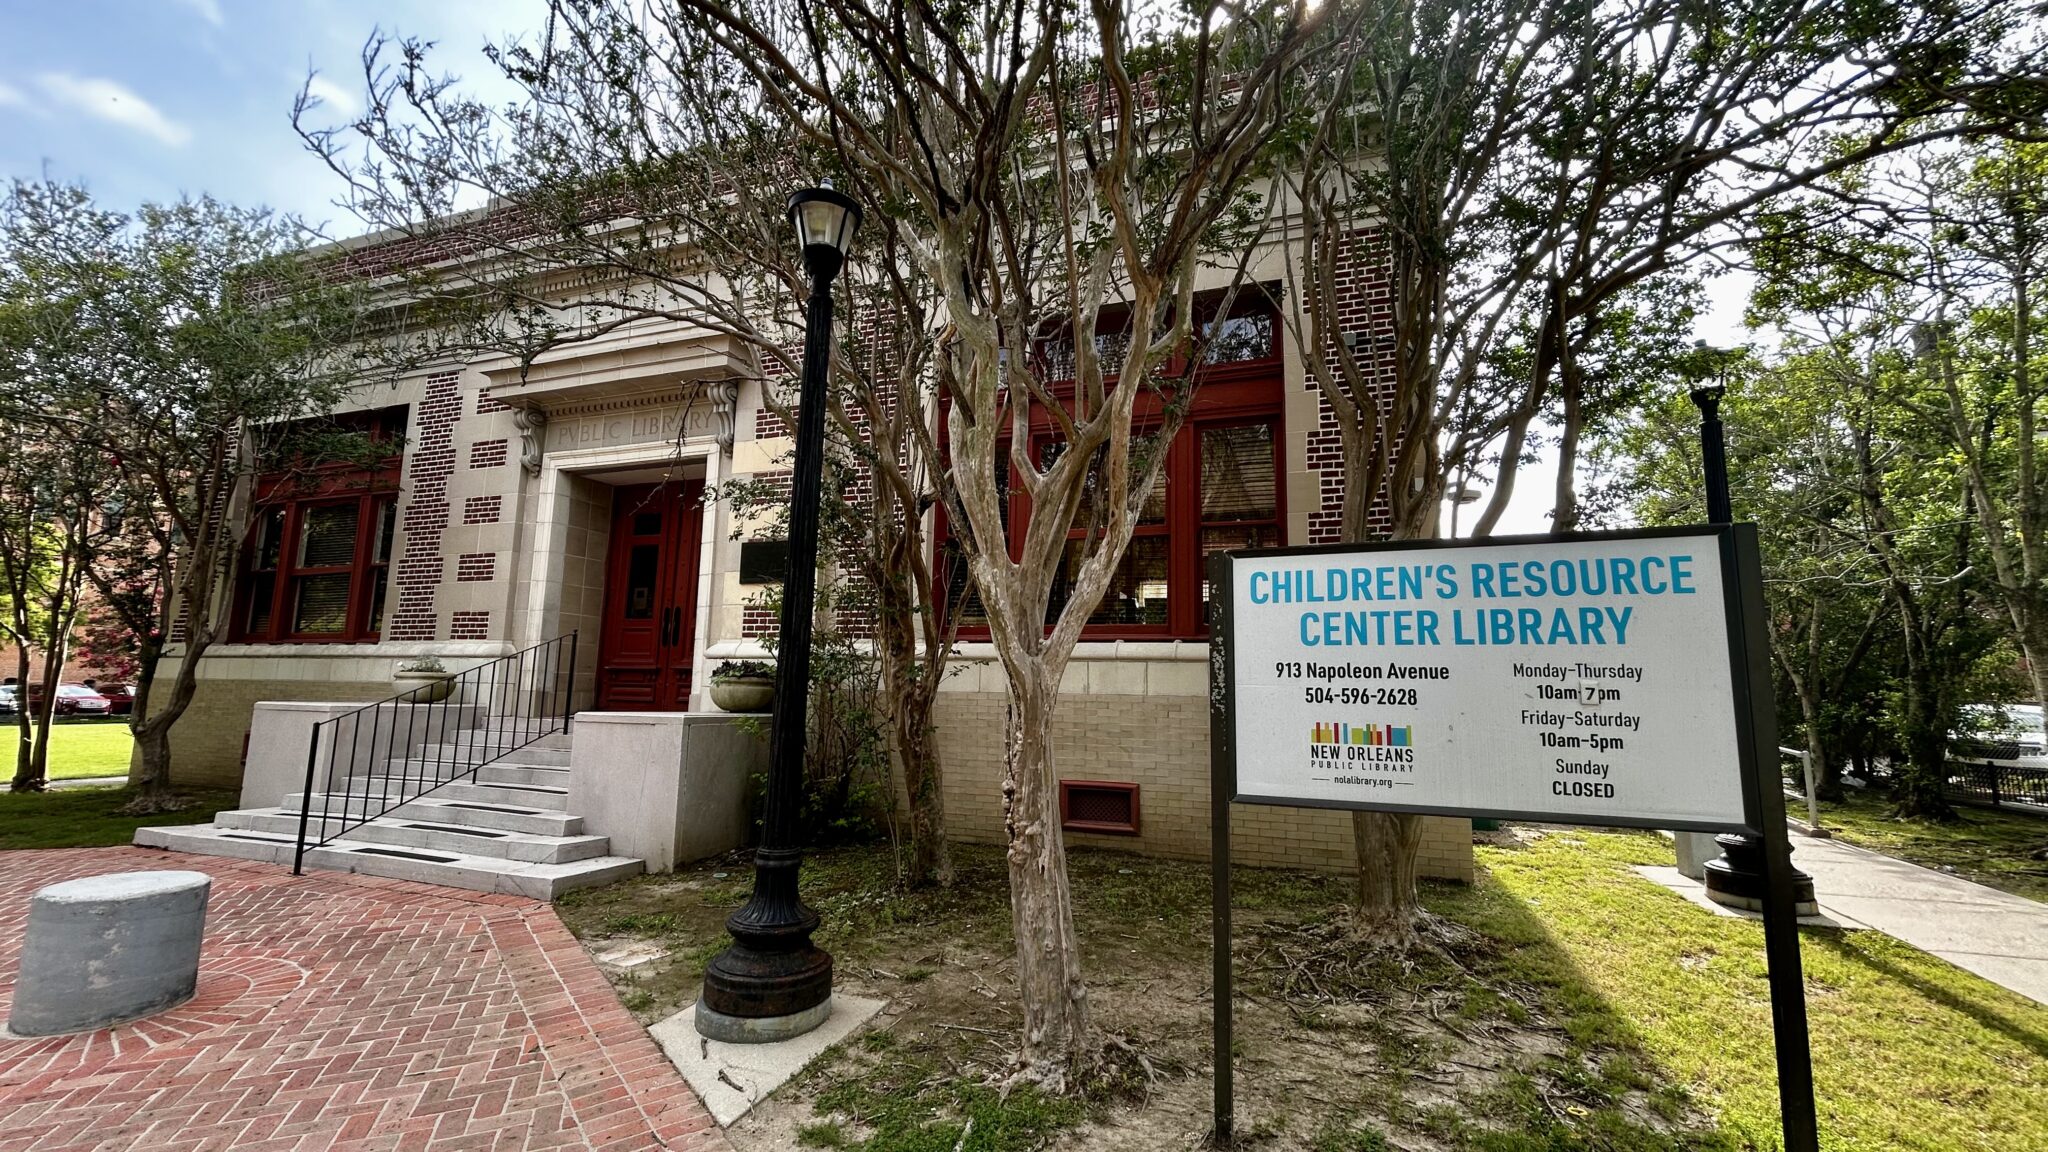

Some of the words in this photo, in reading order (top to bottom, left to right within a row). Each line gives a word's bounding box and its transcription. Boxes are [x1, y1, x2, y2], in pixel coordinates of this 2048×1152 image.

[633, 410, 713, 437] LIBRARY
[1250, 564, 1458, 605] CHILDREN'S
[1471, 555, 1696, 598] RESOURCE
[1300, 610, 1440, 647] CENTER
[1453, 606, 1633, 645] LIBRARY
[1275, 662, 1302, 678] 913
[1306, 662, 1382, 683] Napoleon
[1387, 663, 1450, 680] Avenue
[1305, 687, 1418, 706] 504-596-2628
[1310, 745, 1341, 760] NEW
[1347, 746, 1414, 763] ORLEANS
[1310, 760, 1354, 770] PUBLIC
[1362, 762, 1414, 773] LIBRARY
[1555, 758, 1609, 779] Sunday
[1334, 775, 1393, 789] nolalibrary.org
[1552, 781, 1615, 799] CLOSED
